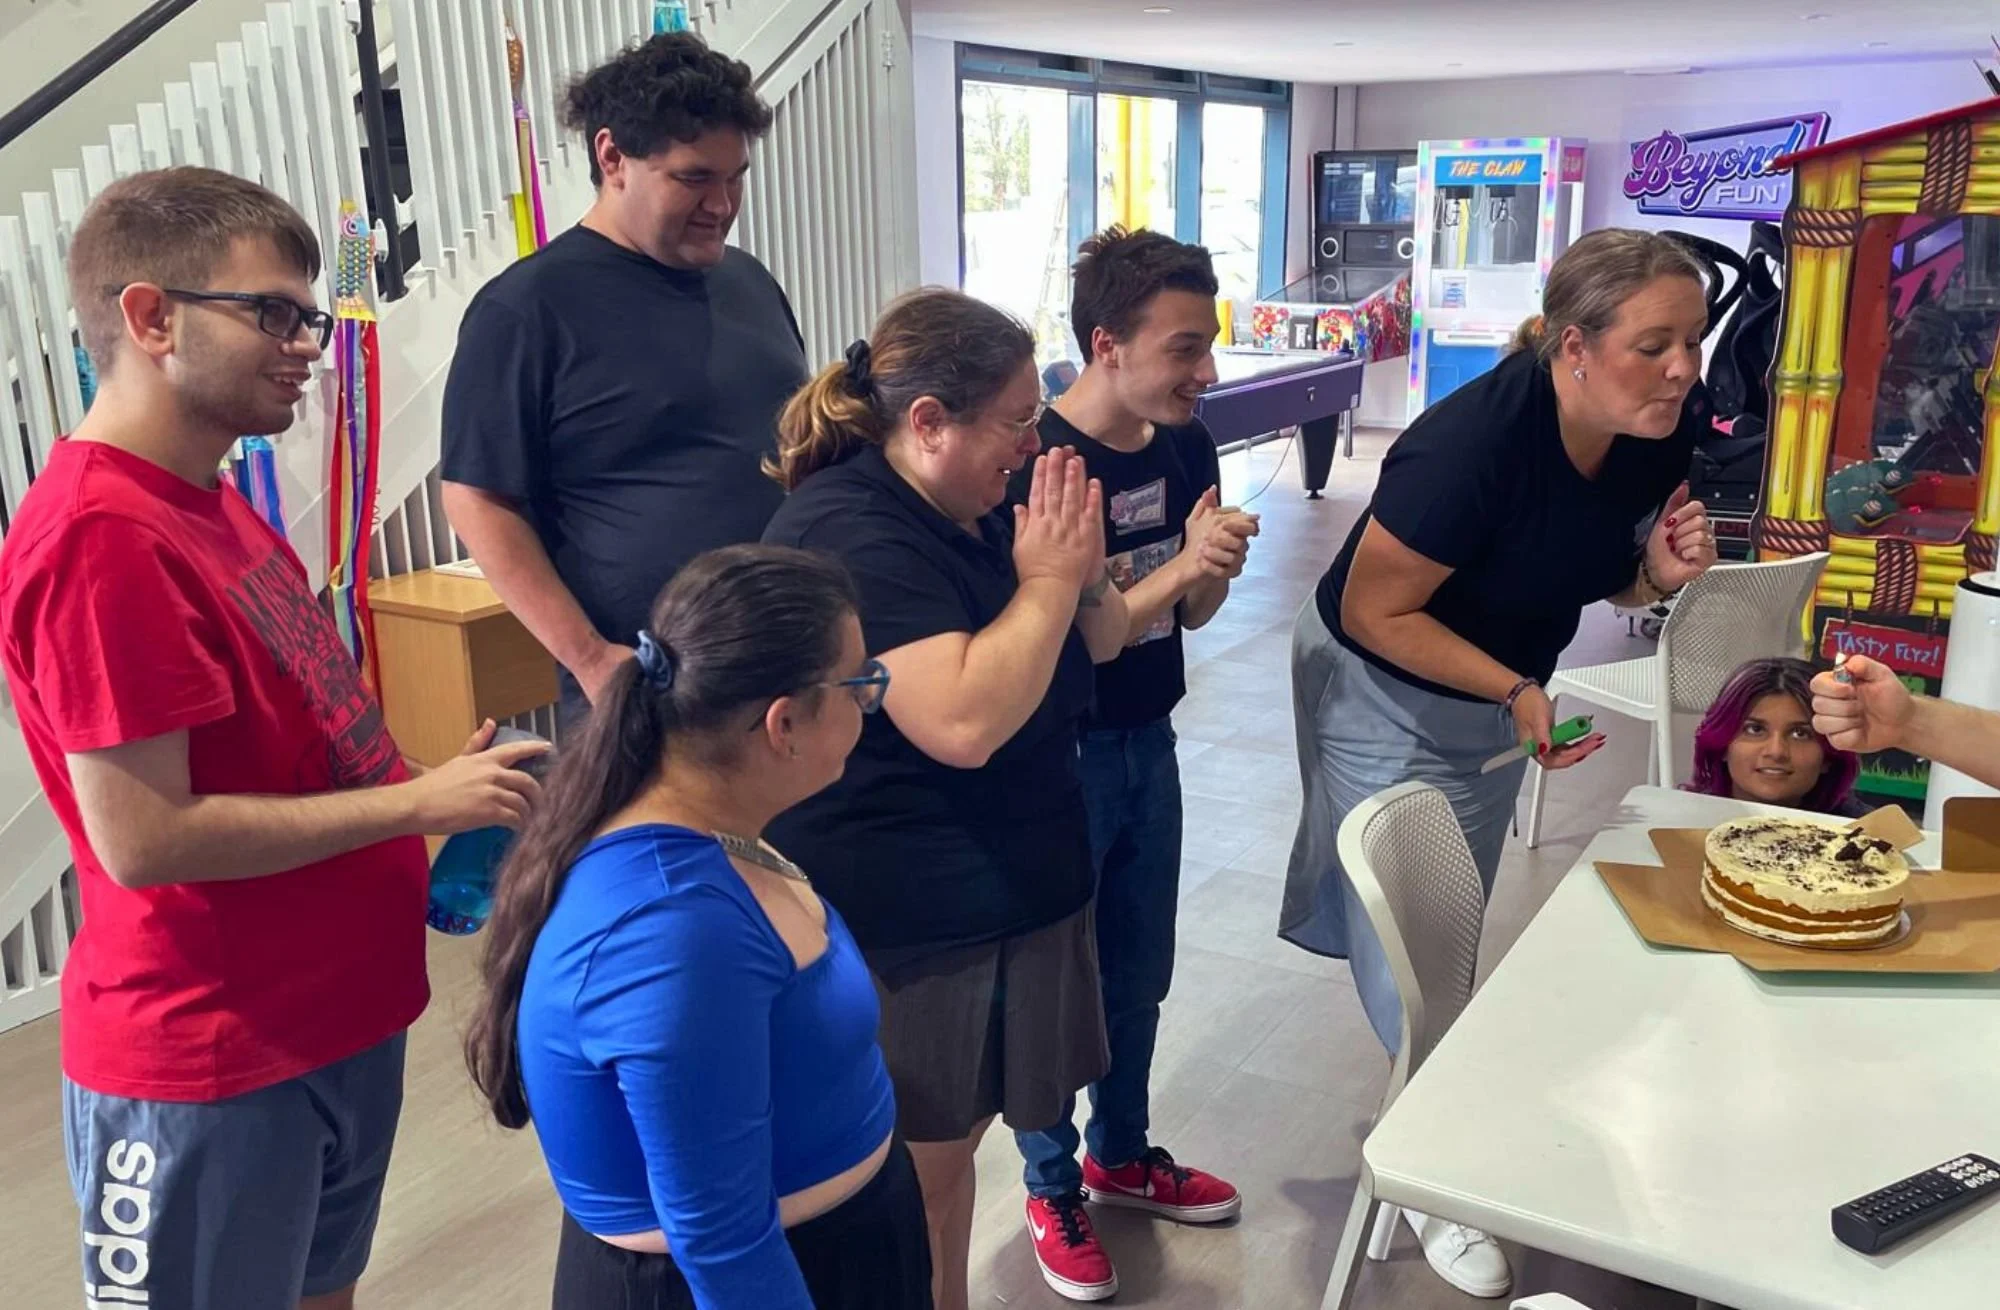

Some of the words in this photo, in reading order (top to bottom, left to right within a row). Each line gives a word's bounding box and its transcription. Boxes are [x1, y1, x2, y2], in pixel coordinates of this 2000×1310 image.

[1450, 161, 1481, 176] THE
[1484, 159, 1526, 176] CLAW
[1624, 120, 1805, 212] Beyond
[1715, 185, 1778, 204] FUN
[1832, 631, 1889, 657] TASTY
[84, 1139, 156, 1310] idas
